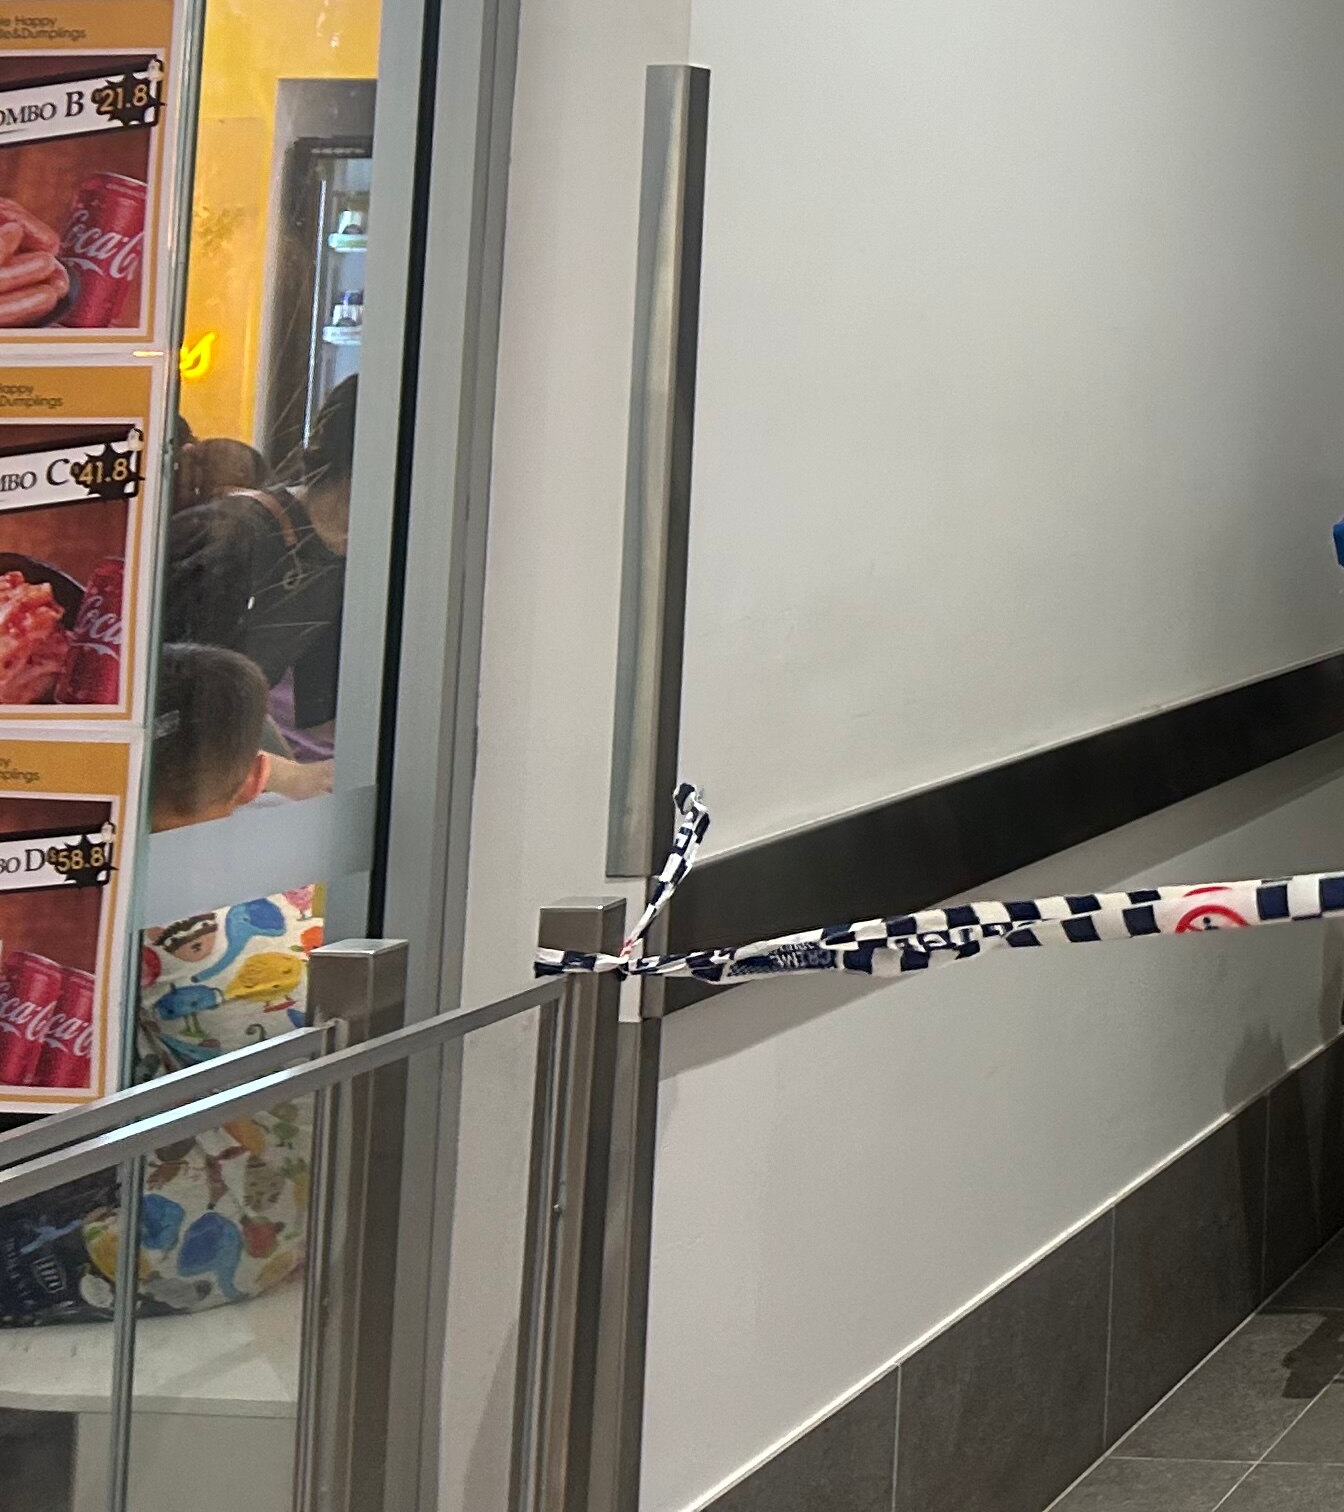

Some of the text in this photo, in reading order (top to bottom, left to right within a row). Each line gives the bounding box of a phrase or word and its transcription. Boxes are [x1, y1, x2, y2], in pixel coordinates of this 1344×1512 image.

[65, 90, 85, 118] B
[46, 457, 71, 486] C
[24, 848, 46, 872] D
